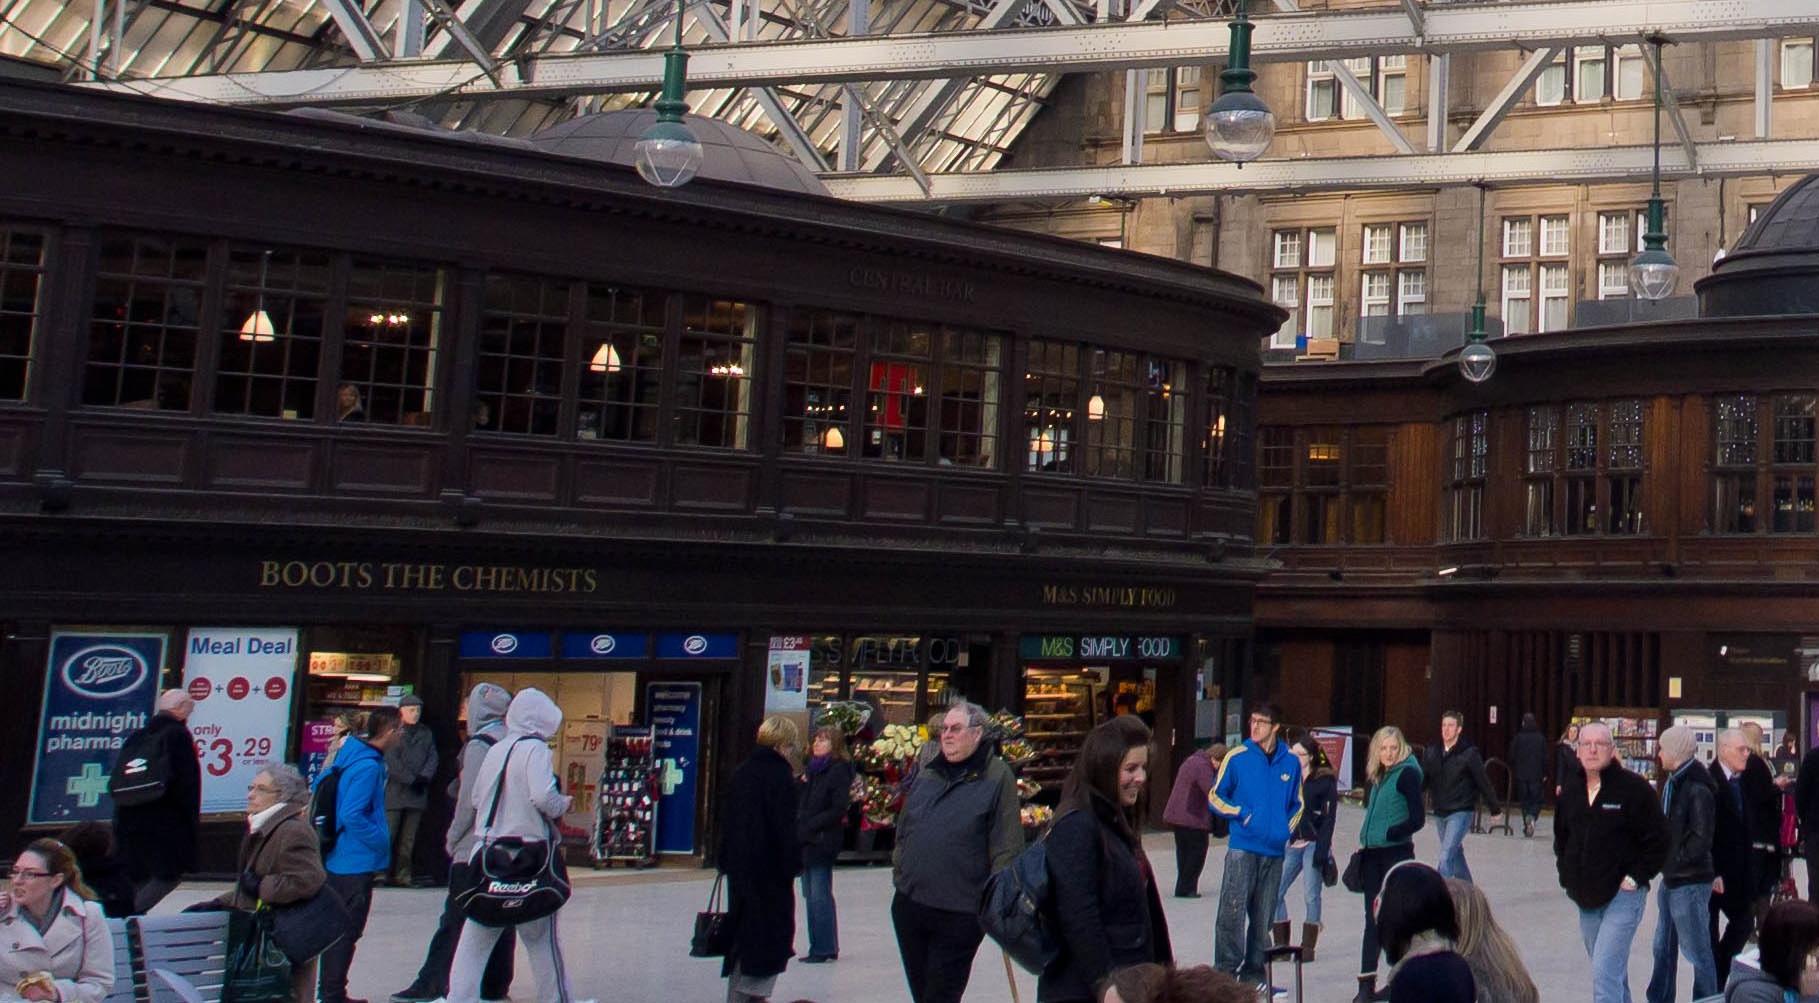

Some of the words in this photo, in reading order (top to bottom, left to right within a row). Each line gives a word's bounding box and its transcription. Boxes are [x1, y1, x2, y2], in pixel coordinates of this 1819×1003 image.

[260, 560, 373, 588] BOOTS
[382, 564, 445, 590] THE
[453, 565, 597, 593] CHEMISTS
[1043, 585, 1077, 604] M&S
[1082, 586, 1138, 606] SIMPLY
[1141, 587, 1175, 606] FOOD
[191, 638, 240, 655] Meal
[247, 638, 292, 655] Deal
[1041, 637, 1074, 657] M&S
[1080, 636, 1130, 657] SIMPLY
[74, 655, 133, 685] Boots
[50, 711, 147, 733] midnight
[193, 723, 222, 737] only
[47, 734, 128, 753] pharma
